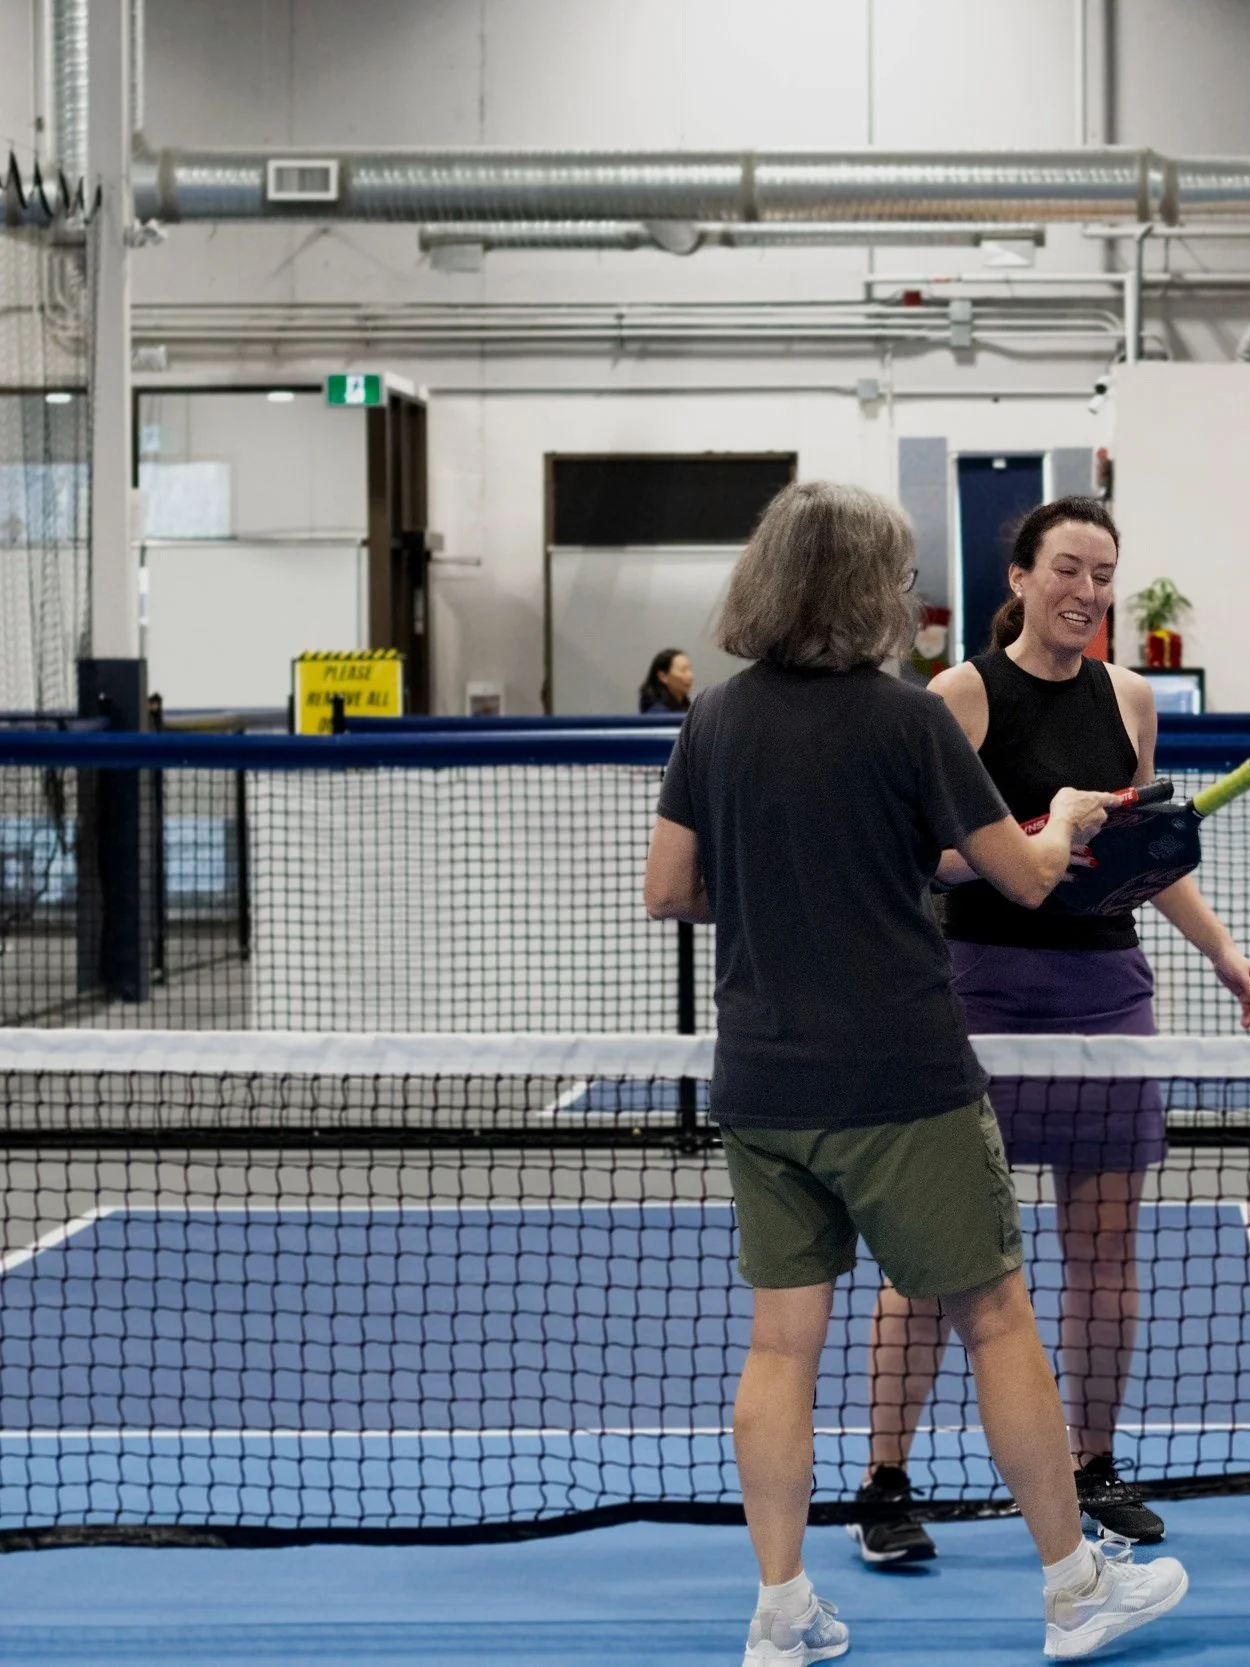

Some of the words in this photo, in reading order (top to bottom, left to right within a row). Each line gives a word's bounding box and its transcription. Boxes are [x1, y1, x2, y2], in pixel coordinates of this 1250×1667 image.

[323, 665, 372, 681] PLEASE
[305, 690, 361, 707] REMVE
[366, 690, 389, 707] ALL
